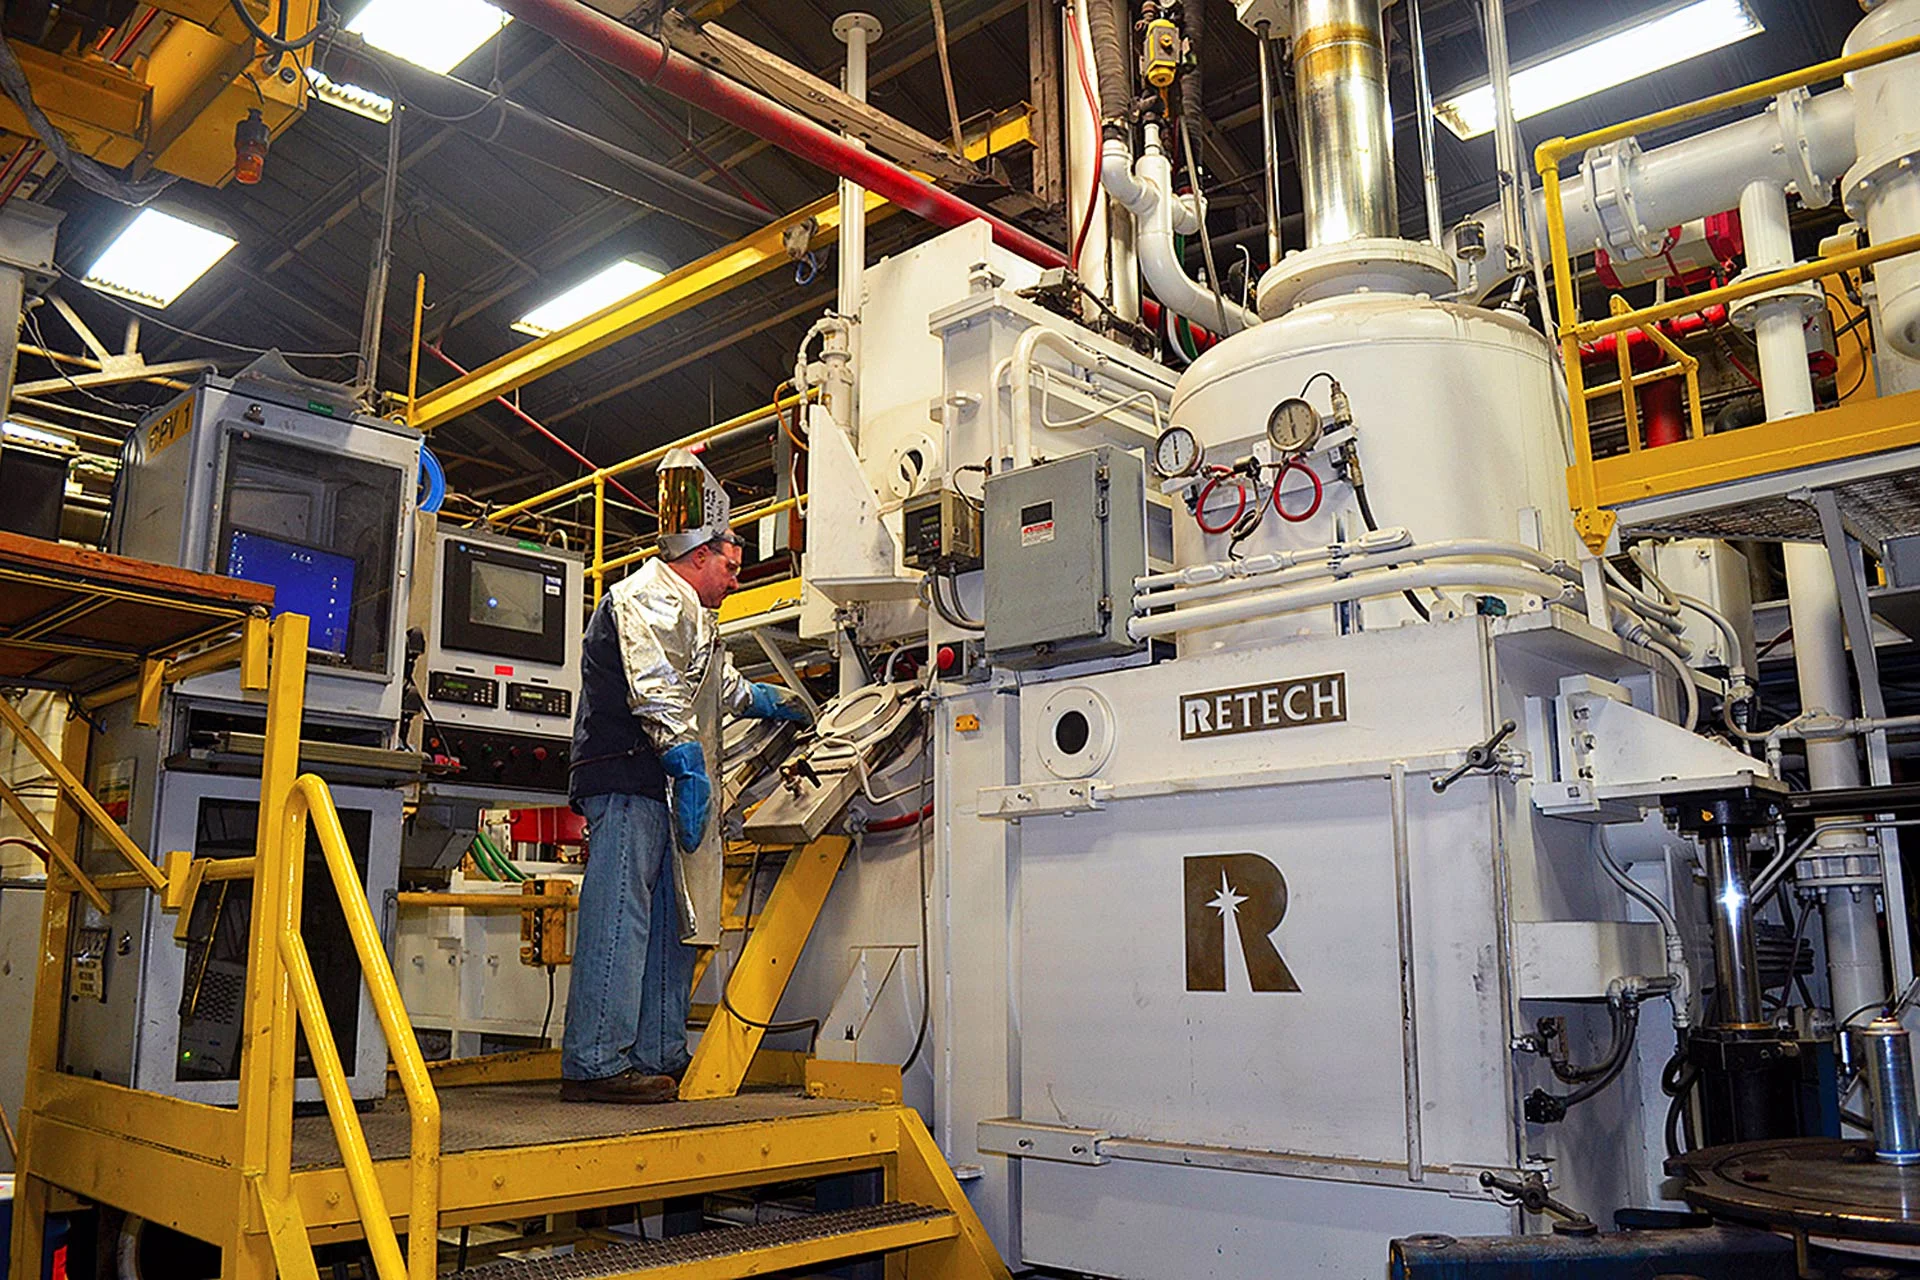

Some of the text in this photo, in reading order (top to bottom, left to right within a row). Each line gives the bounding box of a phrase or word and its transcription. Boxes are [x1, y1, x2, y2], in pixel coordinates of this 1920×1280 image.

[184, 402, 191, 429] 1
[1184, 679, 1341, 735] RETECH
[1184, 853, 1302, 992] R
